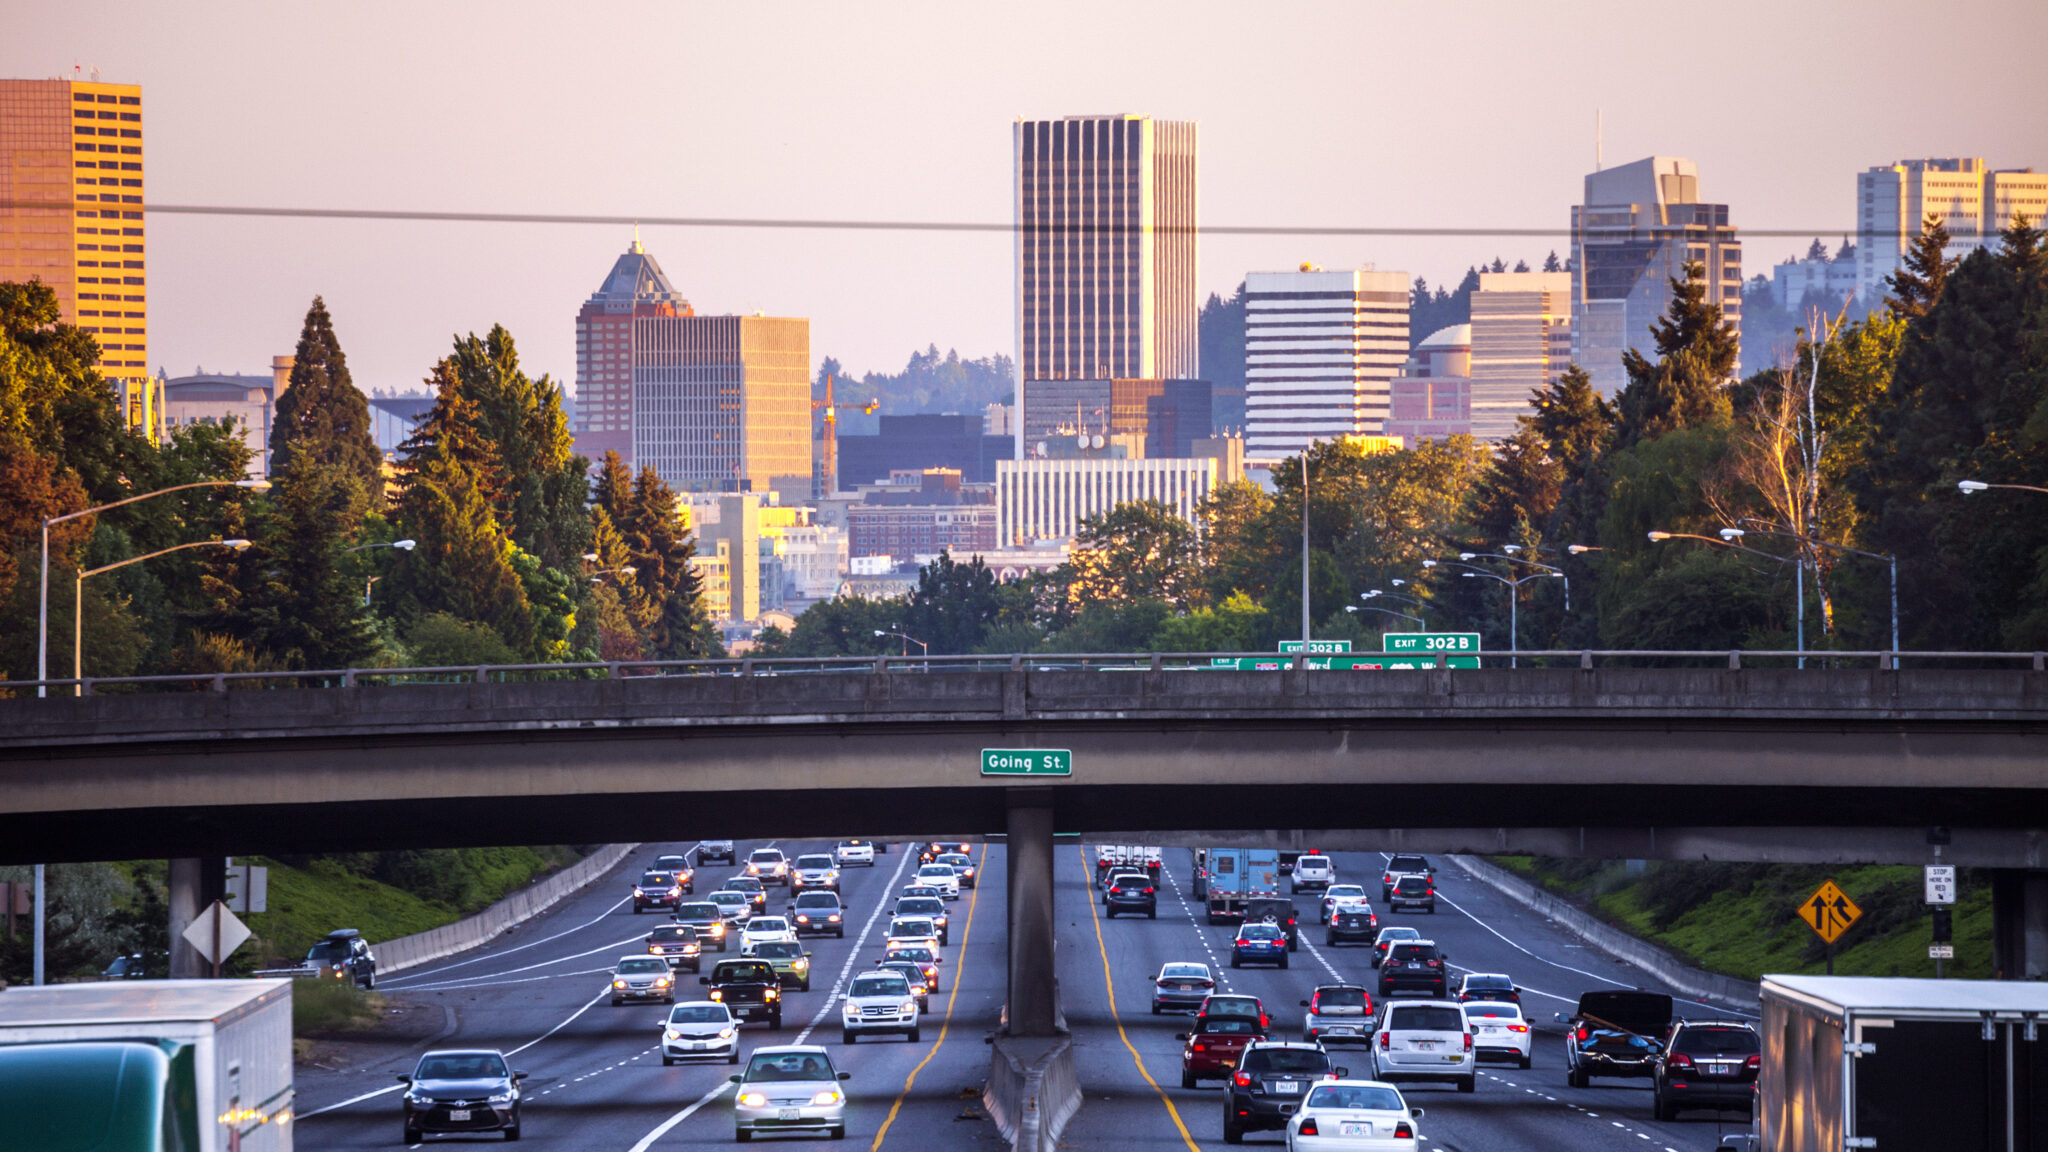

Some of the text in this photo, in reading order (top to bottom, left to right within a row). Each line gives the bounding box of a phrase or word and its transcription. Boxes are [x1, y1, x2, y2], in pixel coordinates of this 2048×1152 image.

[1394, 639, 1417, 648] EXIT
[988, 754, 1064, 772] Going St.
